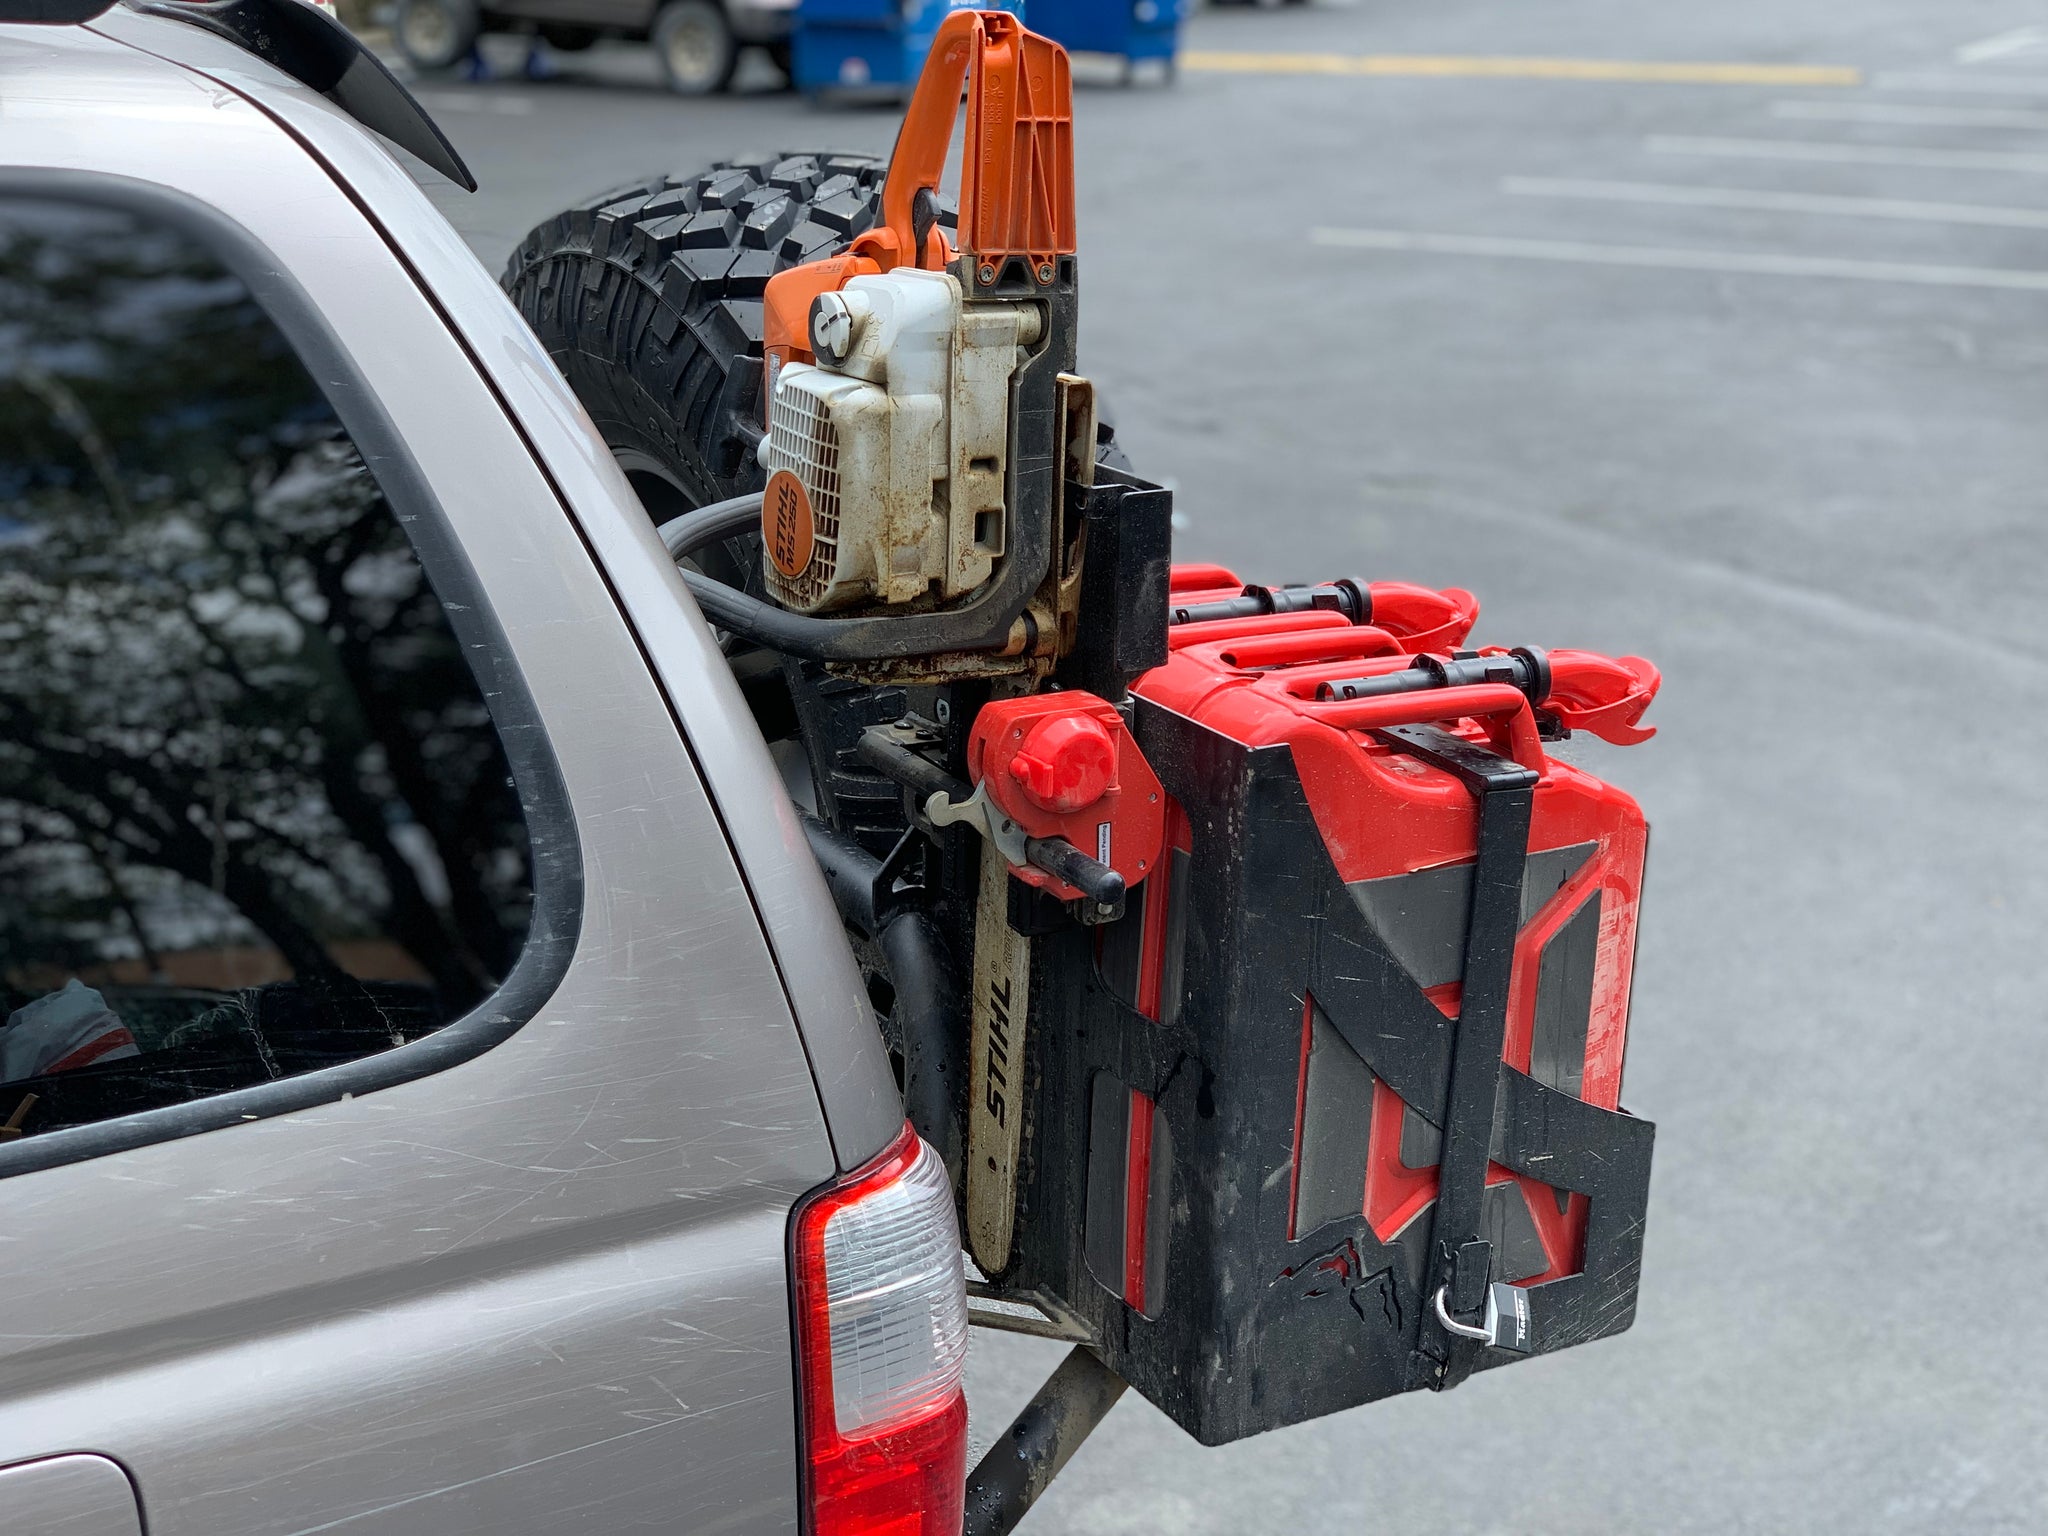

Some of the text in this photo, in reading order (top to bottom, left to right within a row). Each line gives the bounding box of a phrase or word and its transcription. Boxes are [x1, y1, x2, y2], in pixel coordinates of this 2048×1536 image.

[776, 481, 789, 566] STIHL
[786, 488, 798, 570] MS 250
[986, 976, 1010, 1130] STIHL
[1518, 1298, 1526, 1340] Master
